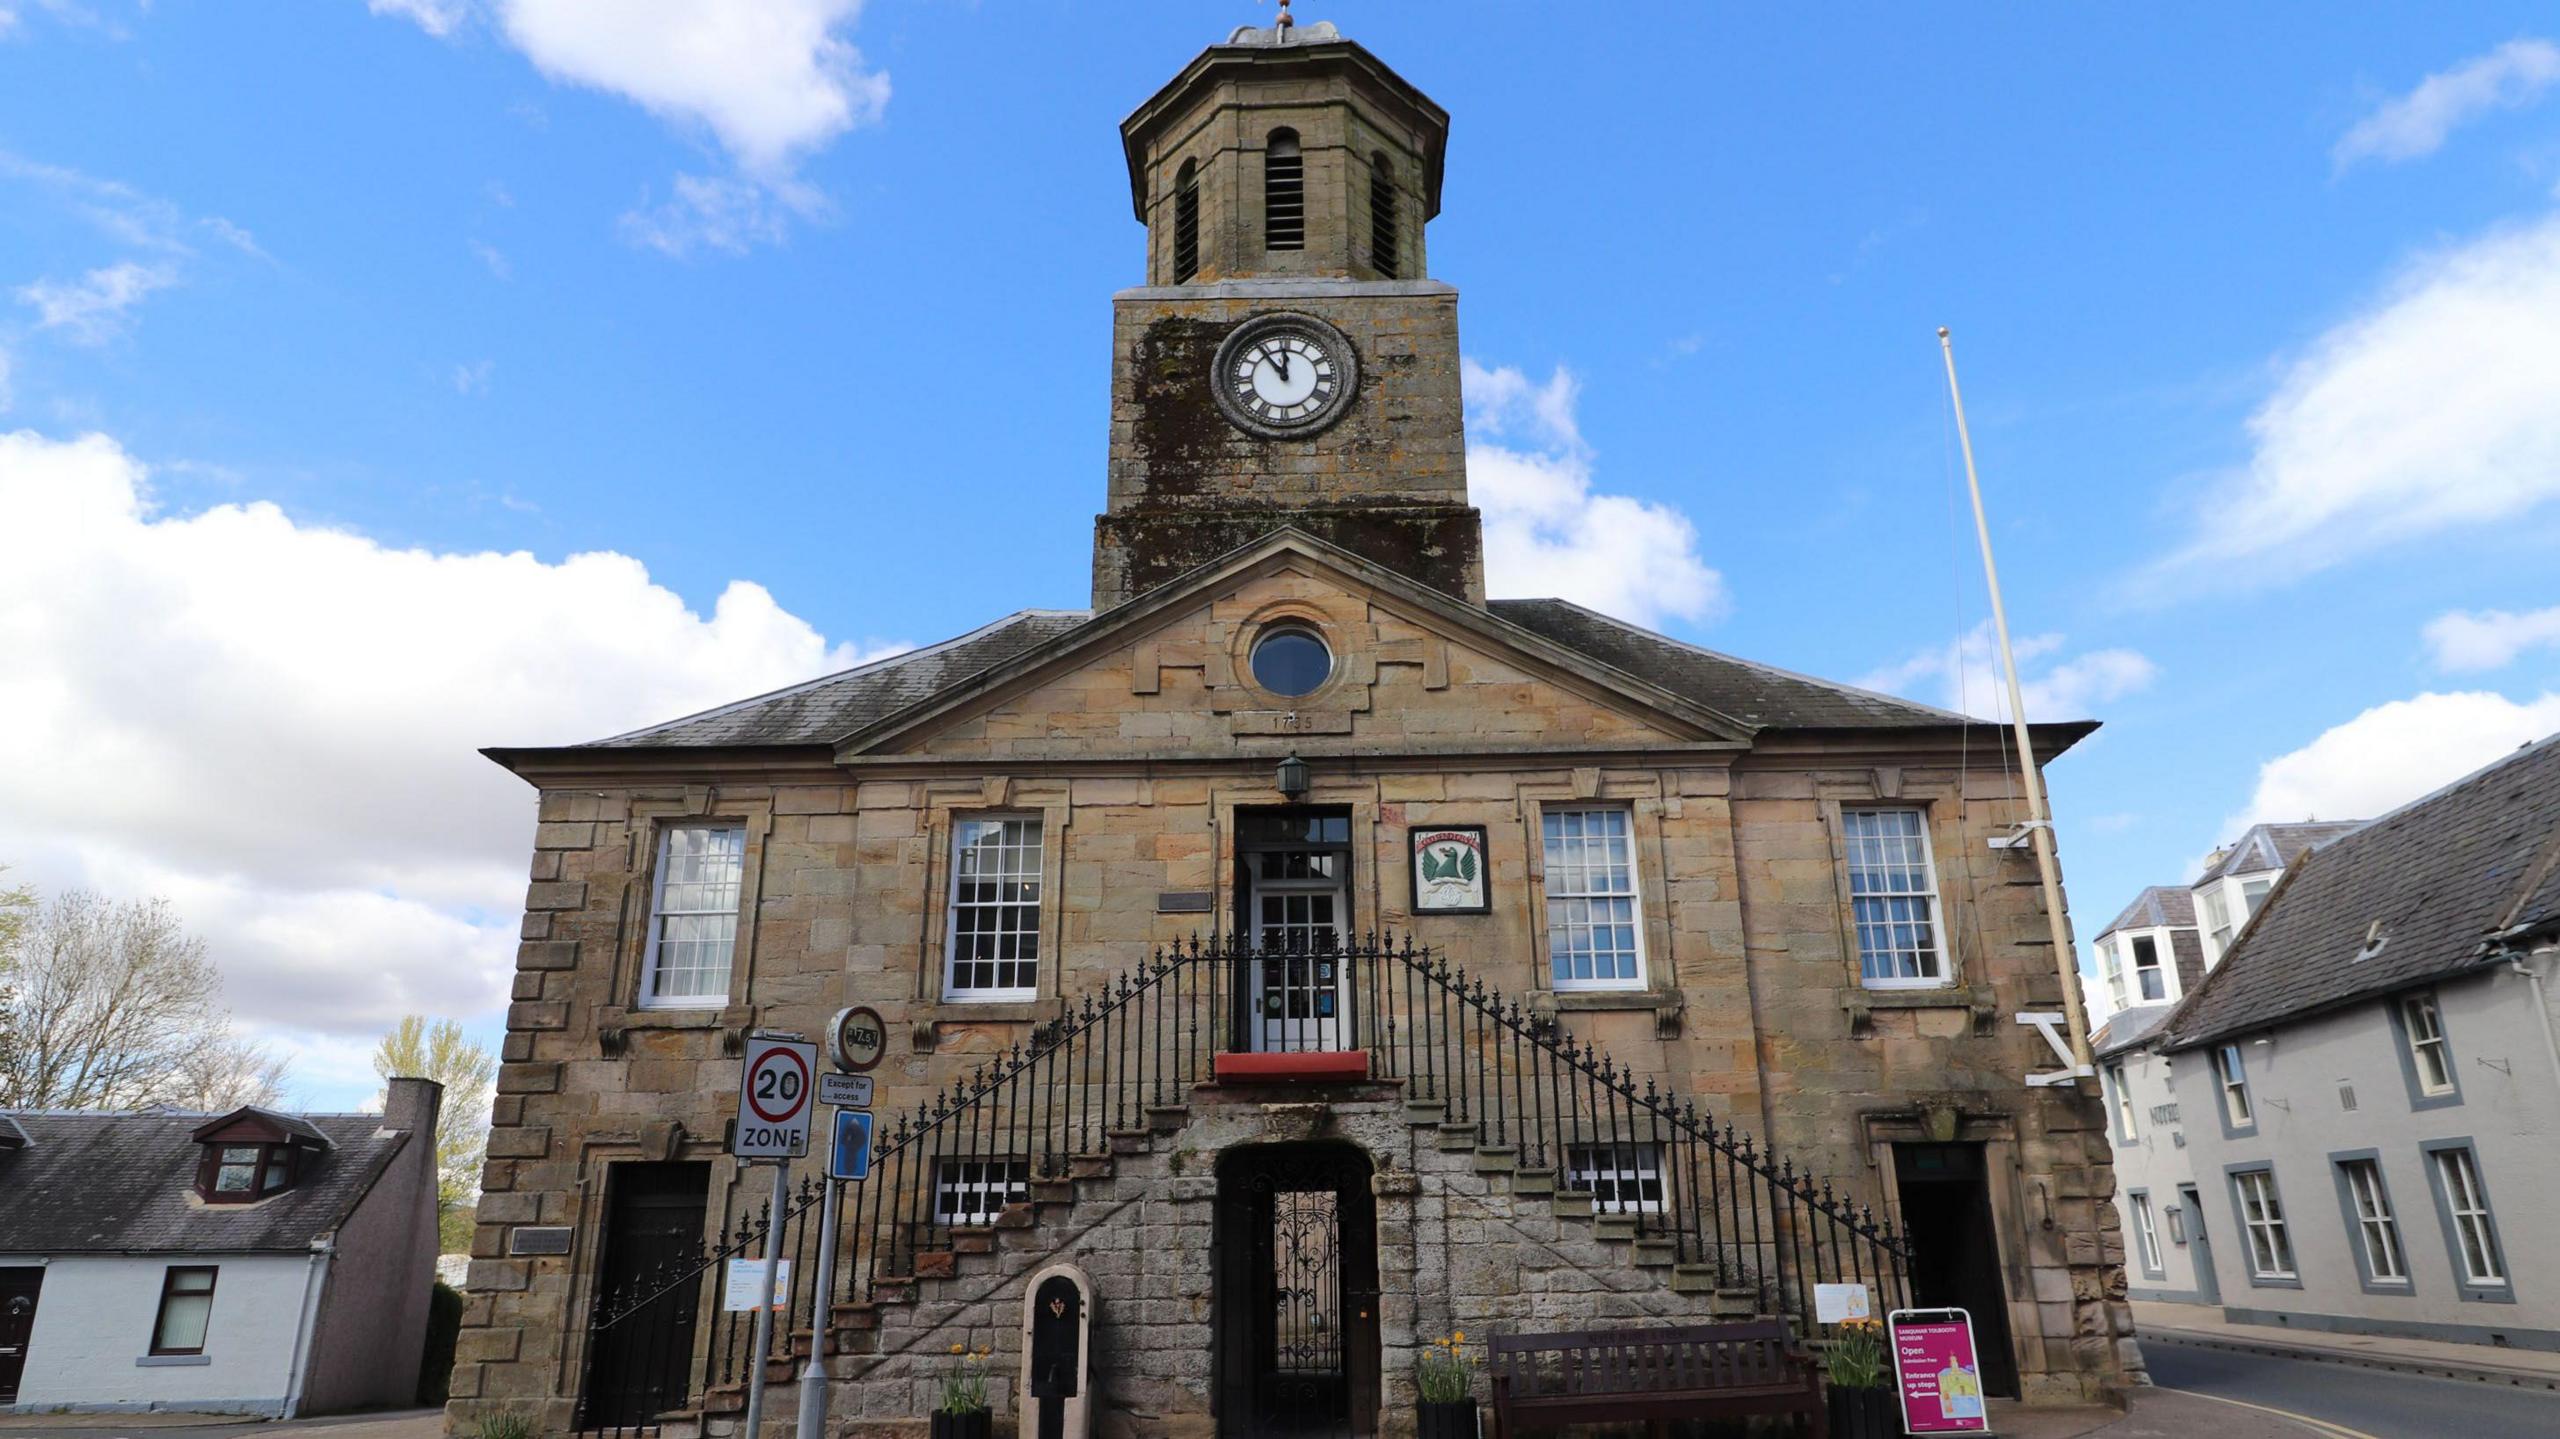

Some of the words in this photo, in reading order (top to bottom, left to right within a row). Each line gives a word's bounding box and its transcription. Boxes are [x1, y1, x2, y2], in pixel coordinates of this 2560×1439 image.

[757, 1069, 800, 1100] 20
[827, 1078, 854, 1090] Except
[855, 1080, 867, 1090] for
[833, 1093, 859, 1101] access
[743, 1128, 801, 1147] ZONE
[1901, 1346, 1924, 1356] Open
[1917, 1381, 1936, 1389] steps
